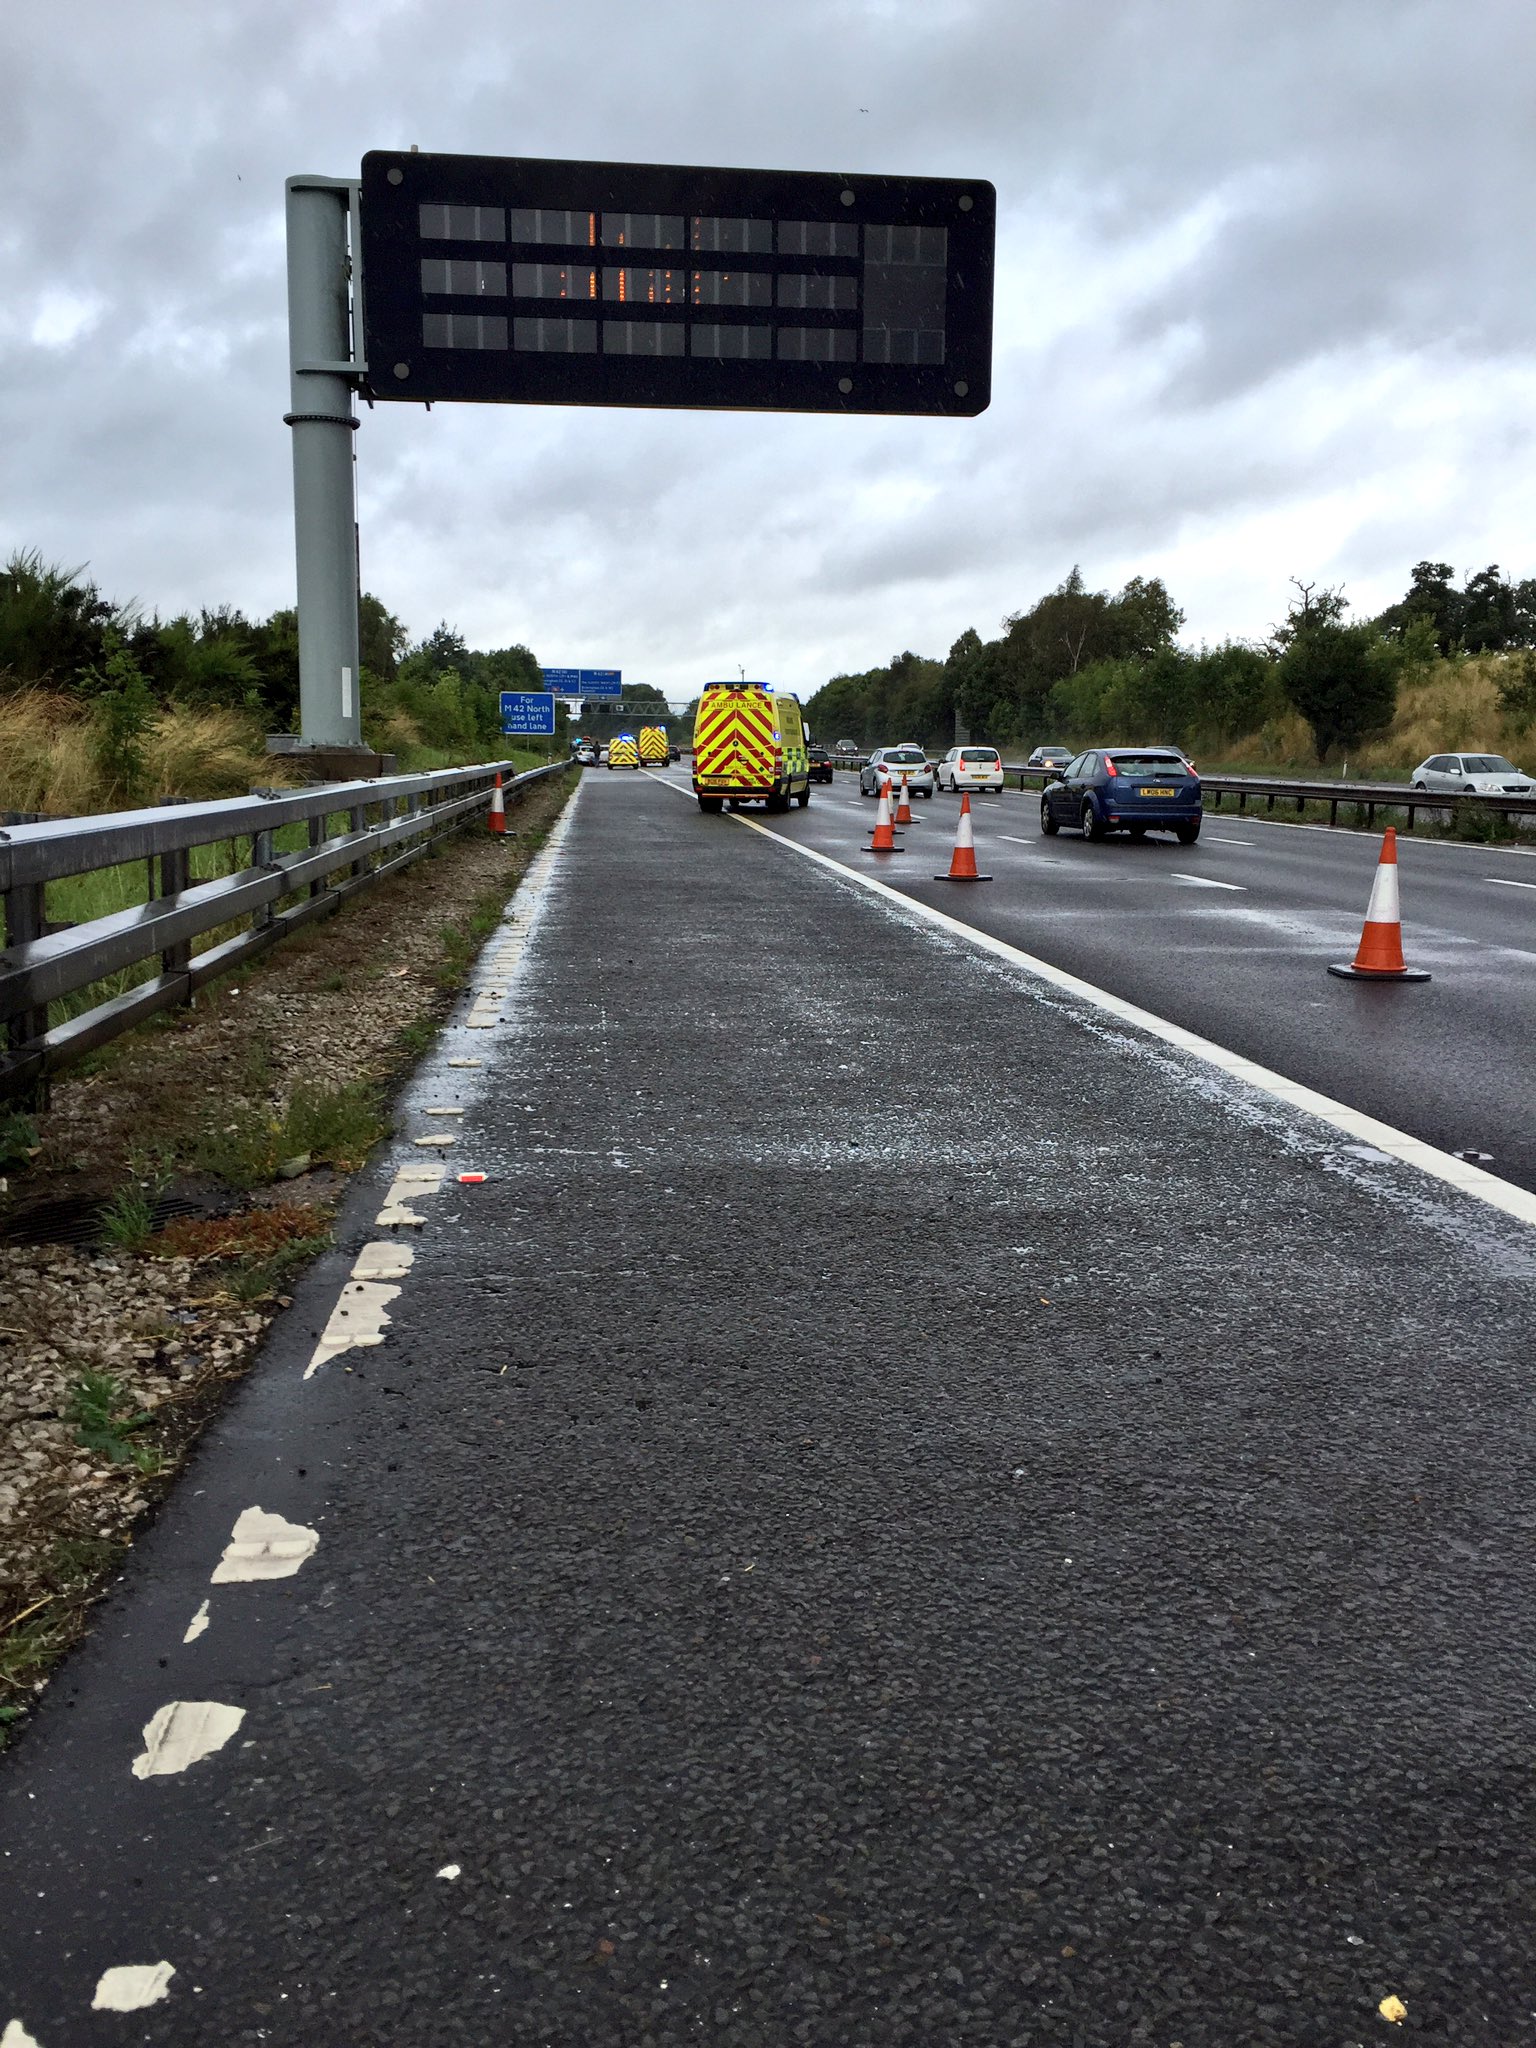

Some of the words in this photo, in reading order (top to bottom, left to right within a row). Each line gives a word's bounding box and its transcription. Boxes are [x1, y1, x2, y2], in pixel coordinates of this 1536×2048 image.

[520, 696, 534, 704] For
[504, 704, 512, 712] M
[513, 704, 525, 712] 42
[526, 705, 550, 713] North
[711, 701, 763, 709] AMBULANCE
[527, 713, 543, 721] left
[529, 722, 547, 730] lane
